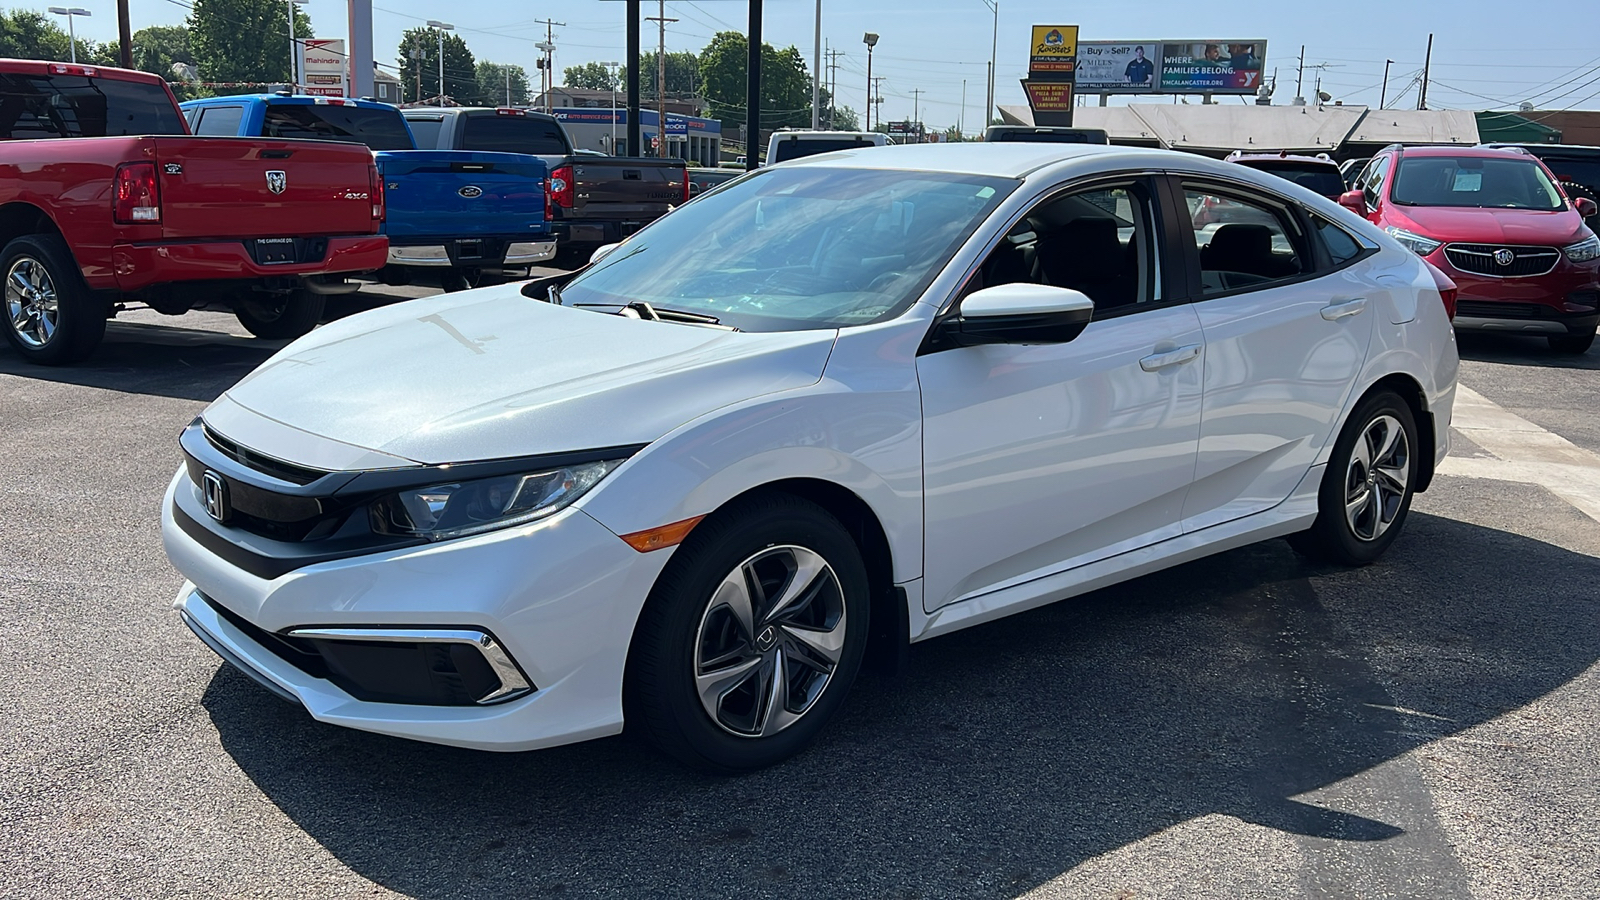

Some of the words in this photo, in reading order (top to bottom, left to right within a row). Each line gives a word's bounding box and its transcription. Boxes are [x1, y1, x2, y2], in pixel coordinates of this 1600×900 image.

[1036, 43, 1072, 55] Roosters
[1087, 47, 1103, 56] Buy
[1111, 46, 1131, 55] Sell?
[1164, 56, 1193, 64] WHERE
[1163, 67, 1200, 75] FAMILIES
[1201, 67, 1236, 75] BELONG.
